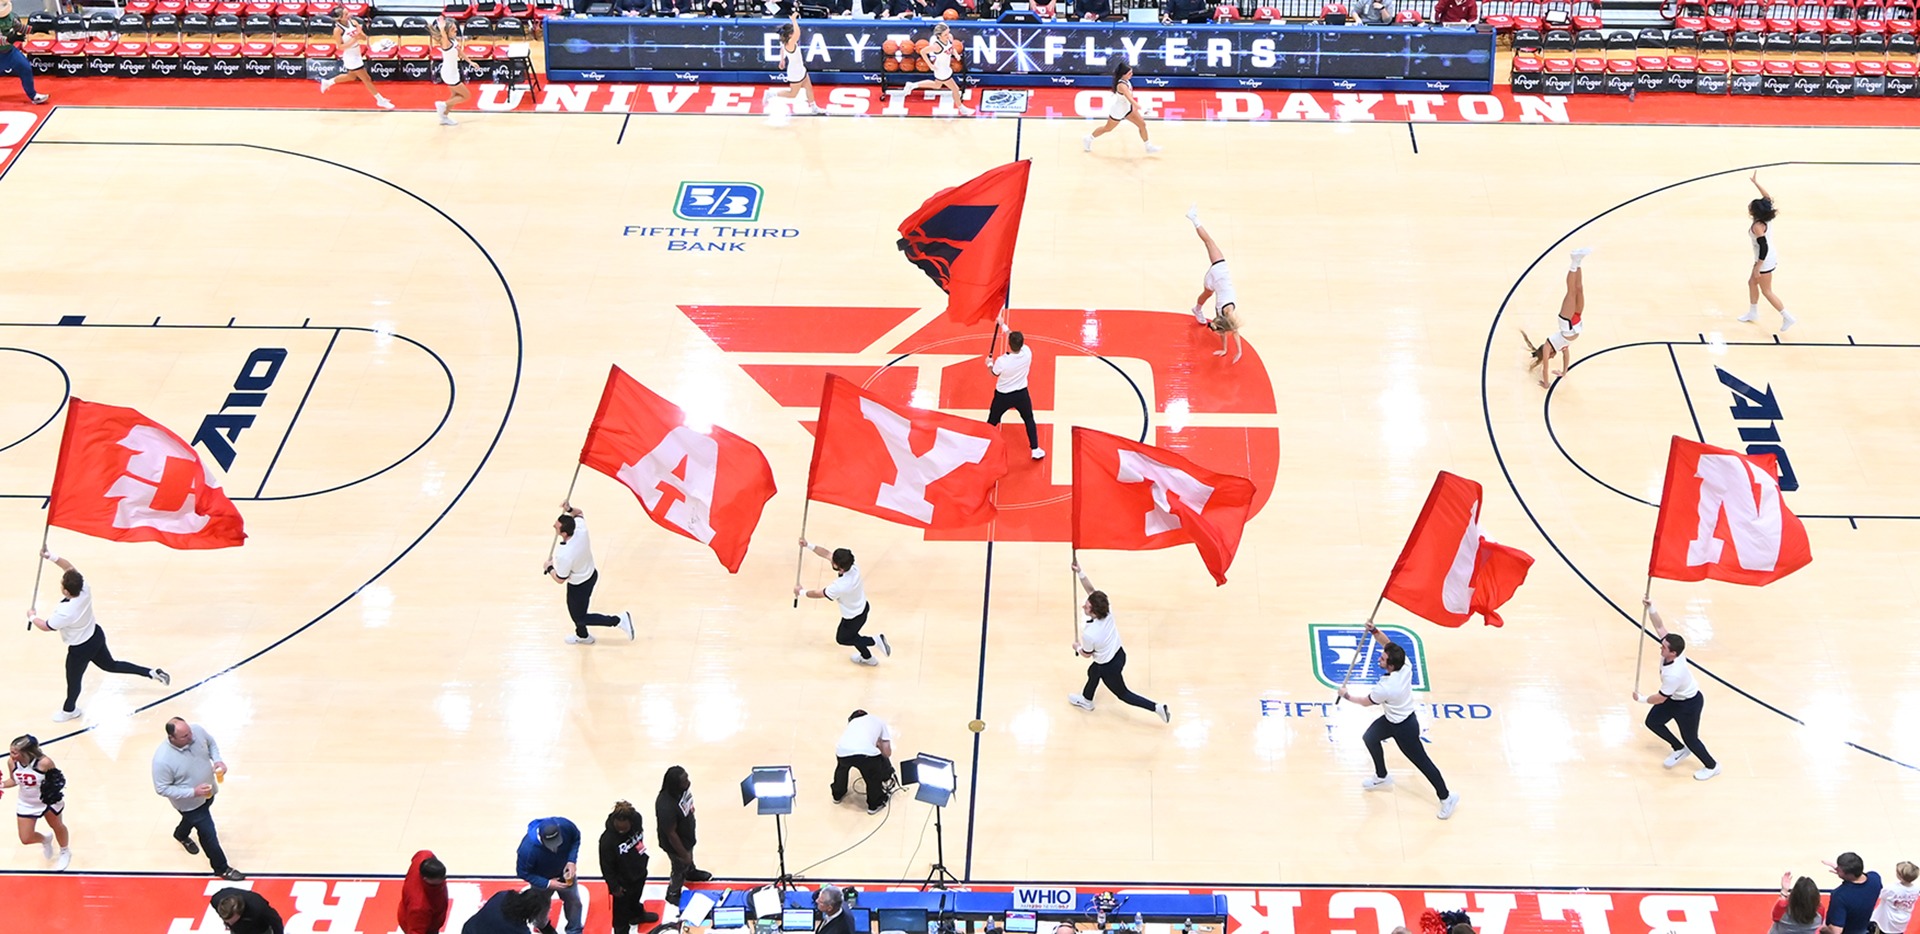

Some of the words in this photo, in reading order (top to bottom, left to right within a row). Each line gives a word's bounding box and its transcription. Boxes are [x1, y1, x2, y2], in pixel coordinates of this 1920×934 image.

[1044, 36, 1277, 69] FLYERS
[1514, 75, 1540, 90] Kroger
[1545, 76, 1571, 91] Kroger
[1576, 75, 1602, 91] Kroger
[1608, 77, 1634, 92] Kroger
[1638, 74, 1663, 89] Kroger
[1668, 74, 1694, 89] Kroger
[1699, 76, 1725, 91] Kroger
[1733, 77, 1759, 92] Kroger
[1764, 77, 1790, 93] Kroger
[1795, 78, 1820, 94] Kroger
[1826, 79, 1852, 94] Kroger
[1856, 78, 1882, 93] Kroger
[1887, 79, 1913, 94] Kroger
[477, 83, 1034, 117] UNIVERSIT
[1074, 90, 1176, 118] OF
[1215, 91, 1569, 122] DAYTON
[622, 225, 700, 237] FIFTH
[712, 226, 800, 238] THIRD
[667, 240, 747, 252] BANK
[858, 395, 992, 525] Y
[616, 425, 719, 546] A
[1116, 448, 1215, 537] T
[1686, 453, 1783, 572] N
[1259, 699, 1343, 717] FIFT
[1018, 889, 1071, 904] WHIO
